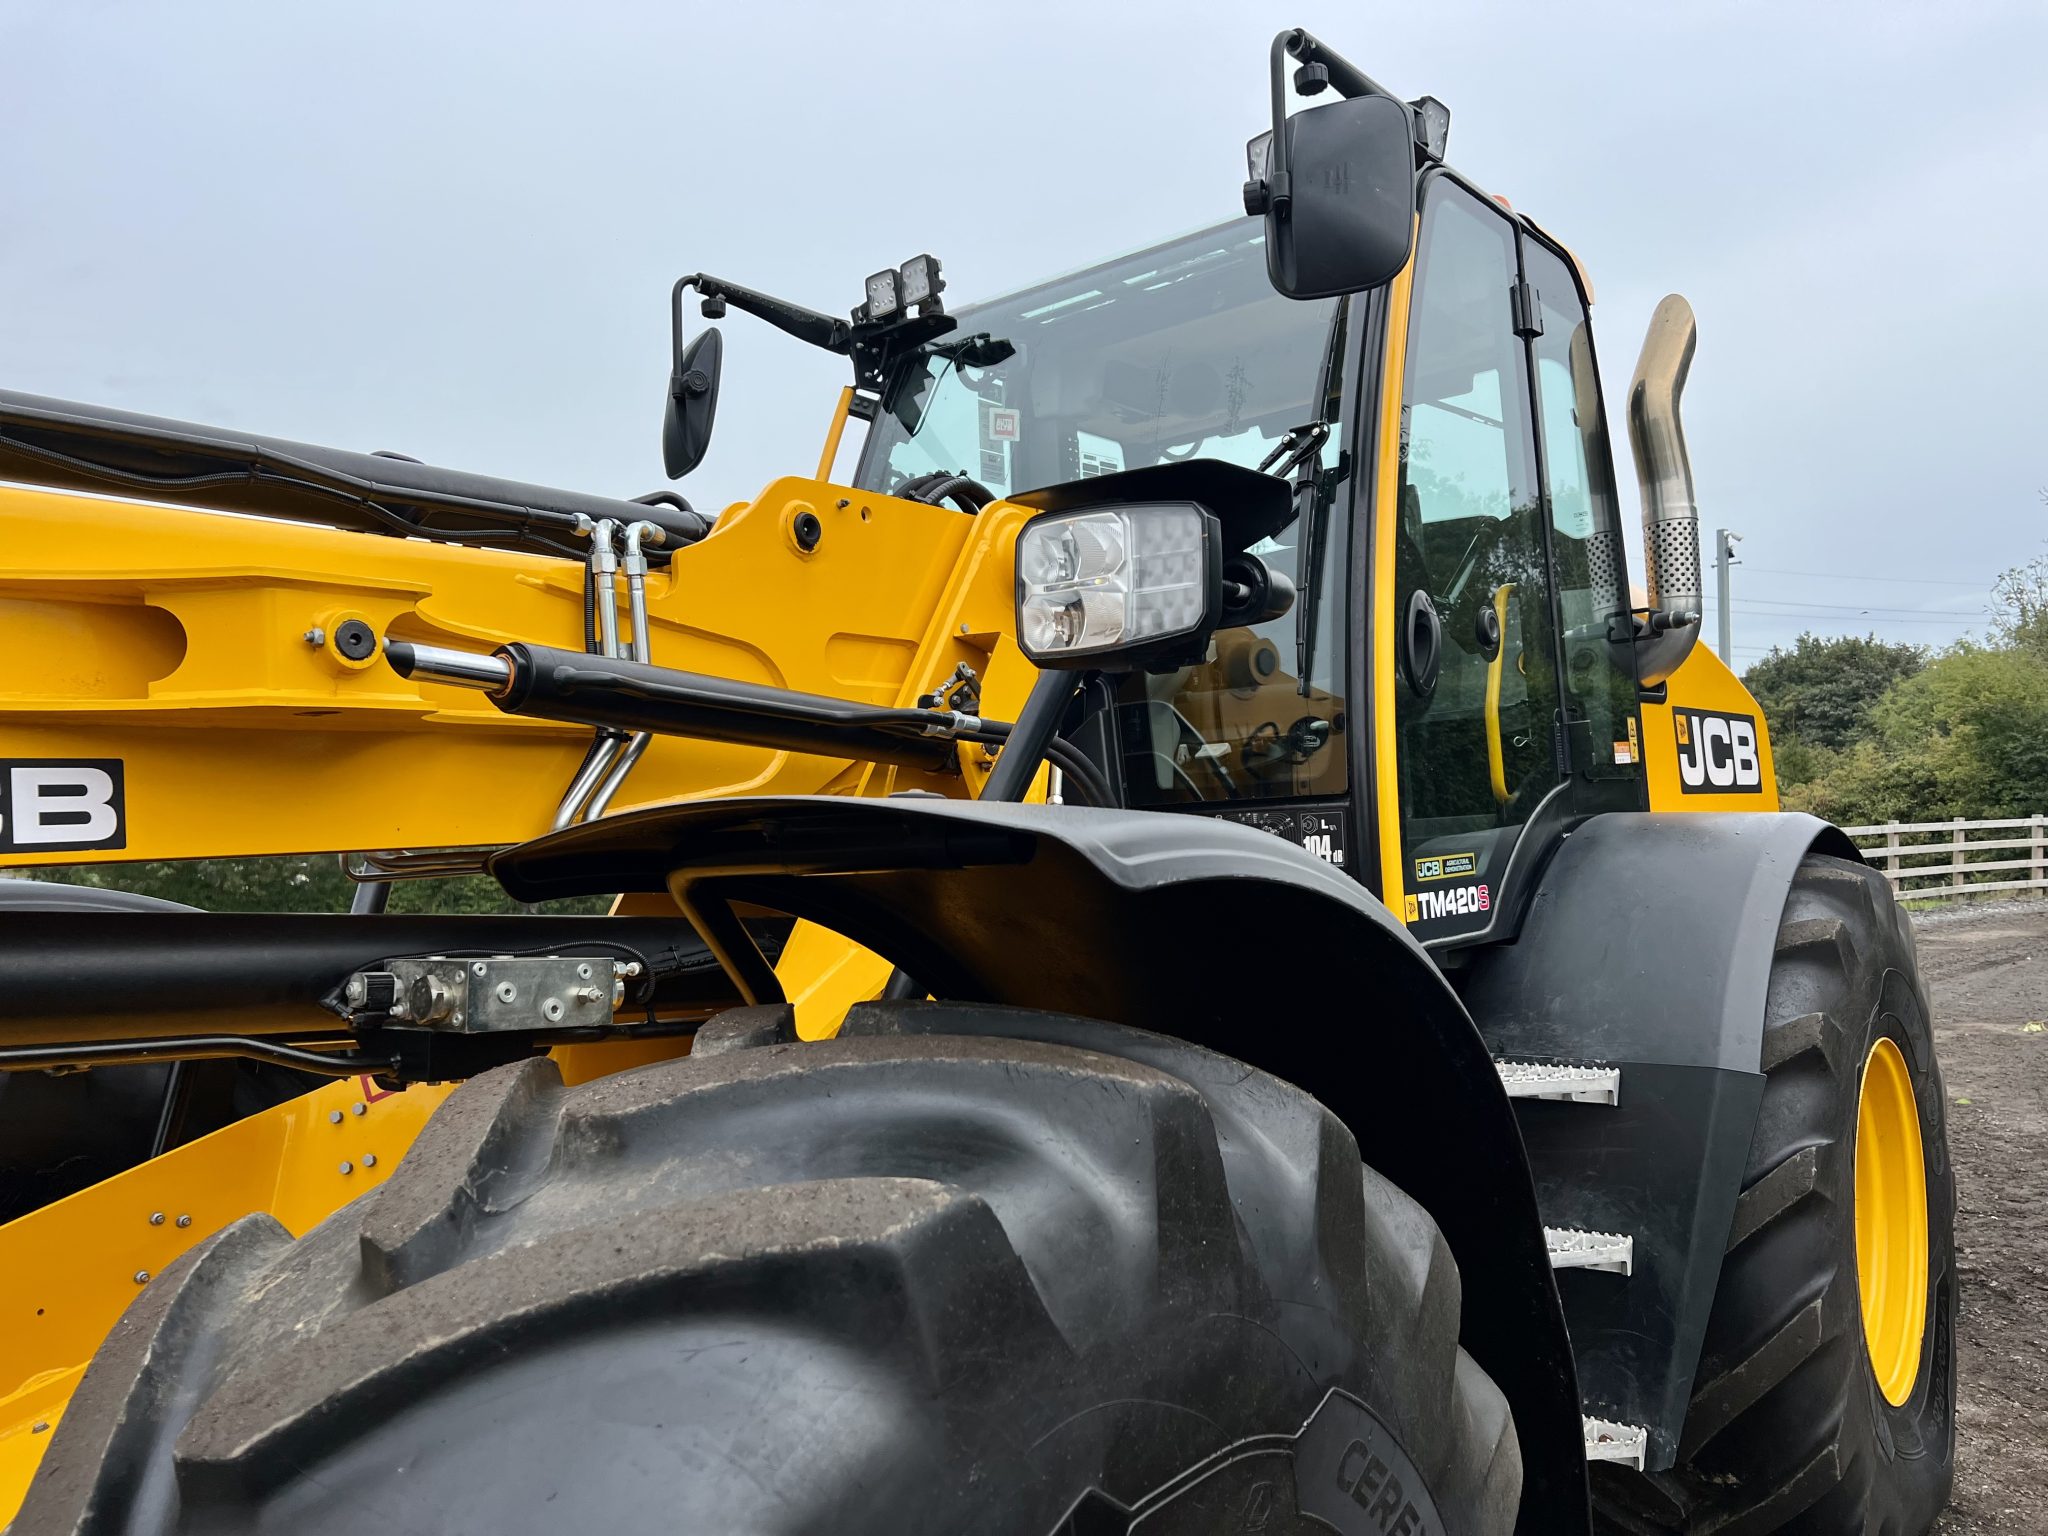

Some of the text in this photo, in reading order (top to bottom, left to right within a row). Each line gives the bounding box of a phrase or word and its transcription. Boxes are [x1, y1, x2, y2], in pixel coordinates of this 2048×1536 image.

[1679, 715, 1759, 786] JCB
[0, 767, 118, 845] B
[1418, 861, 1441, 877] JCB
[1417, 884, 1490, 920] TM420S
